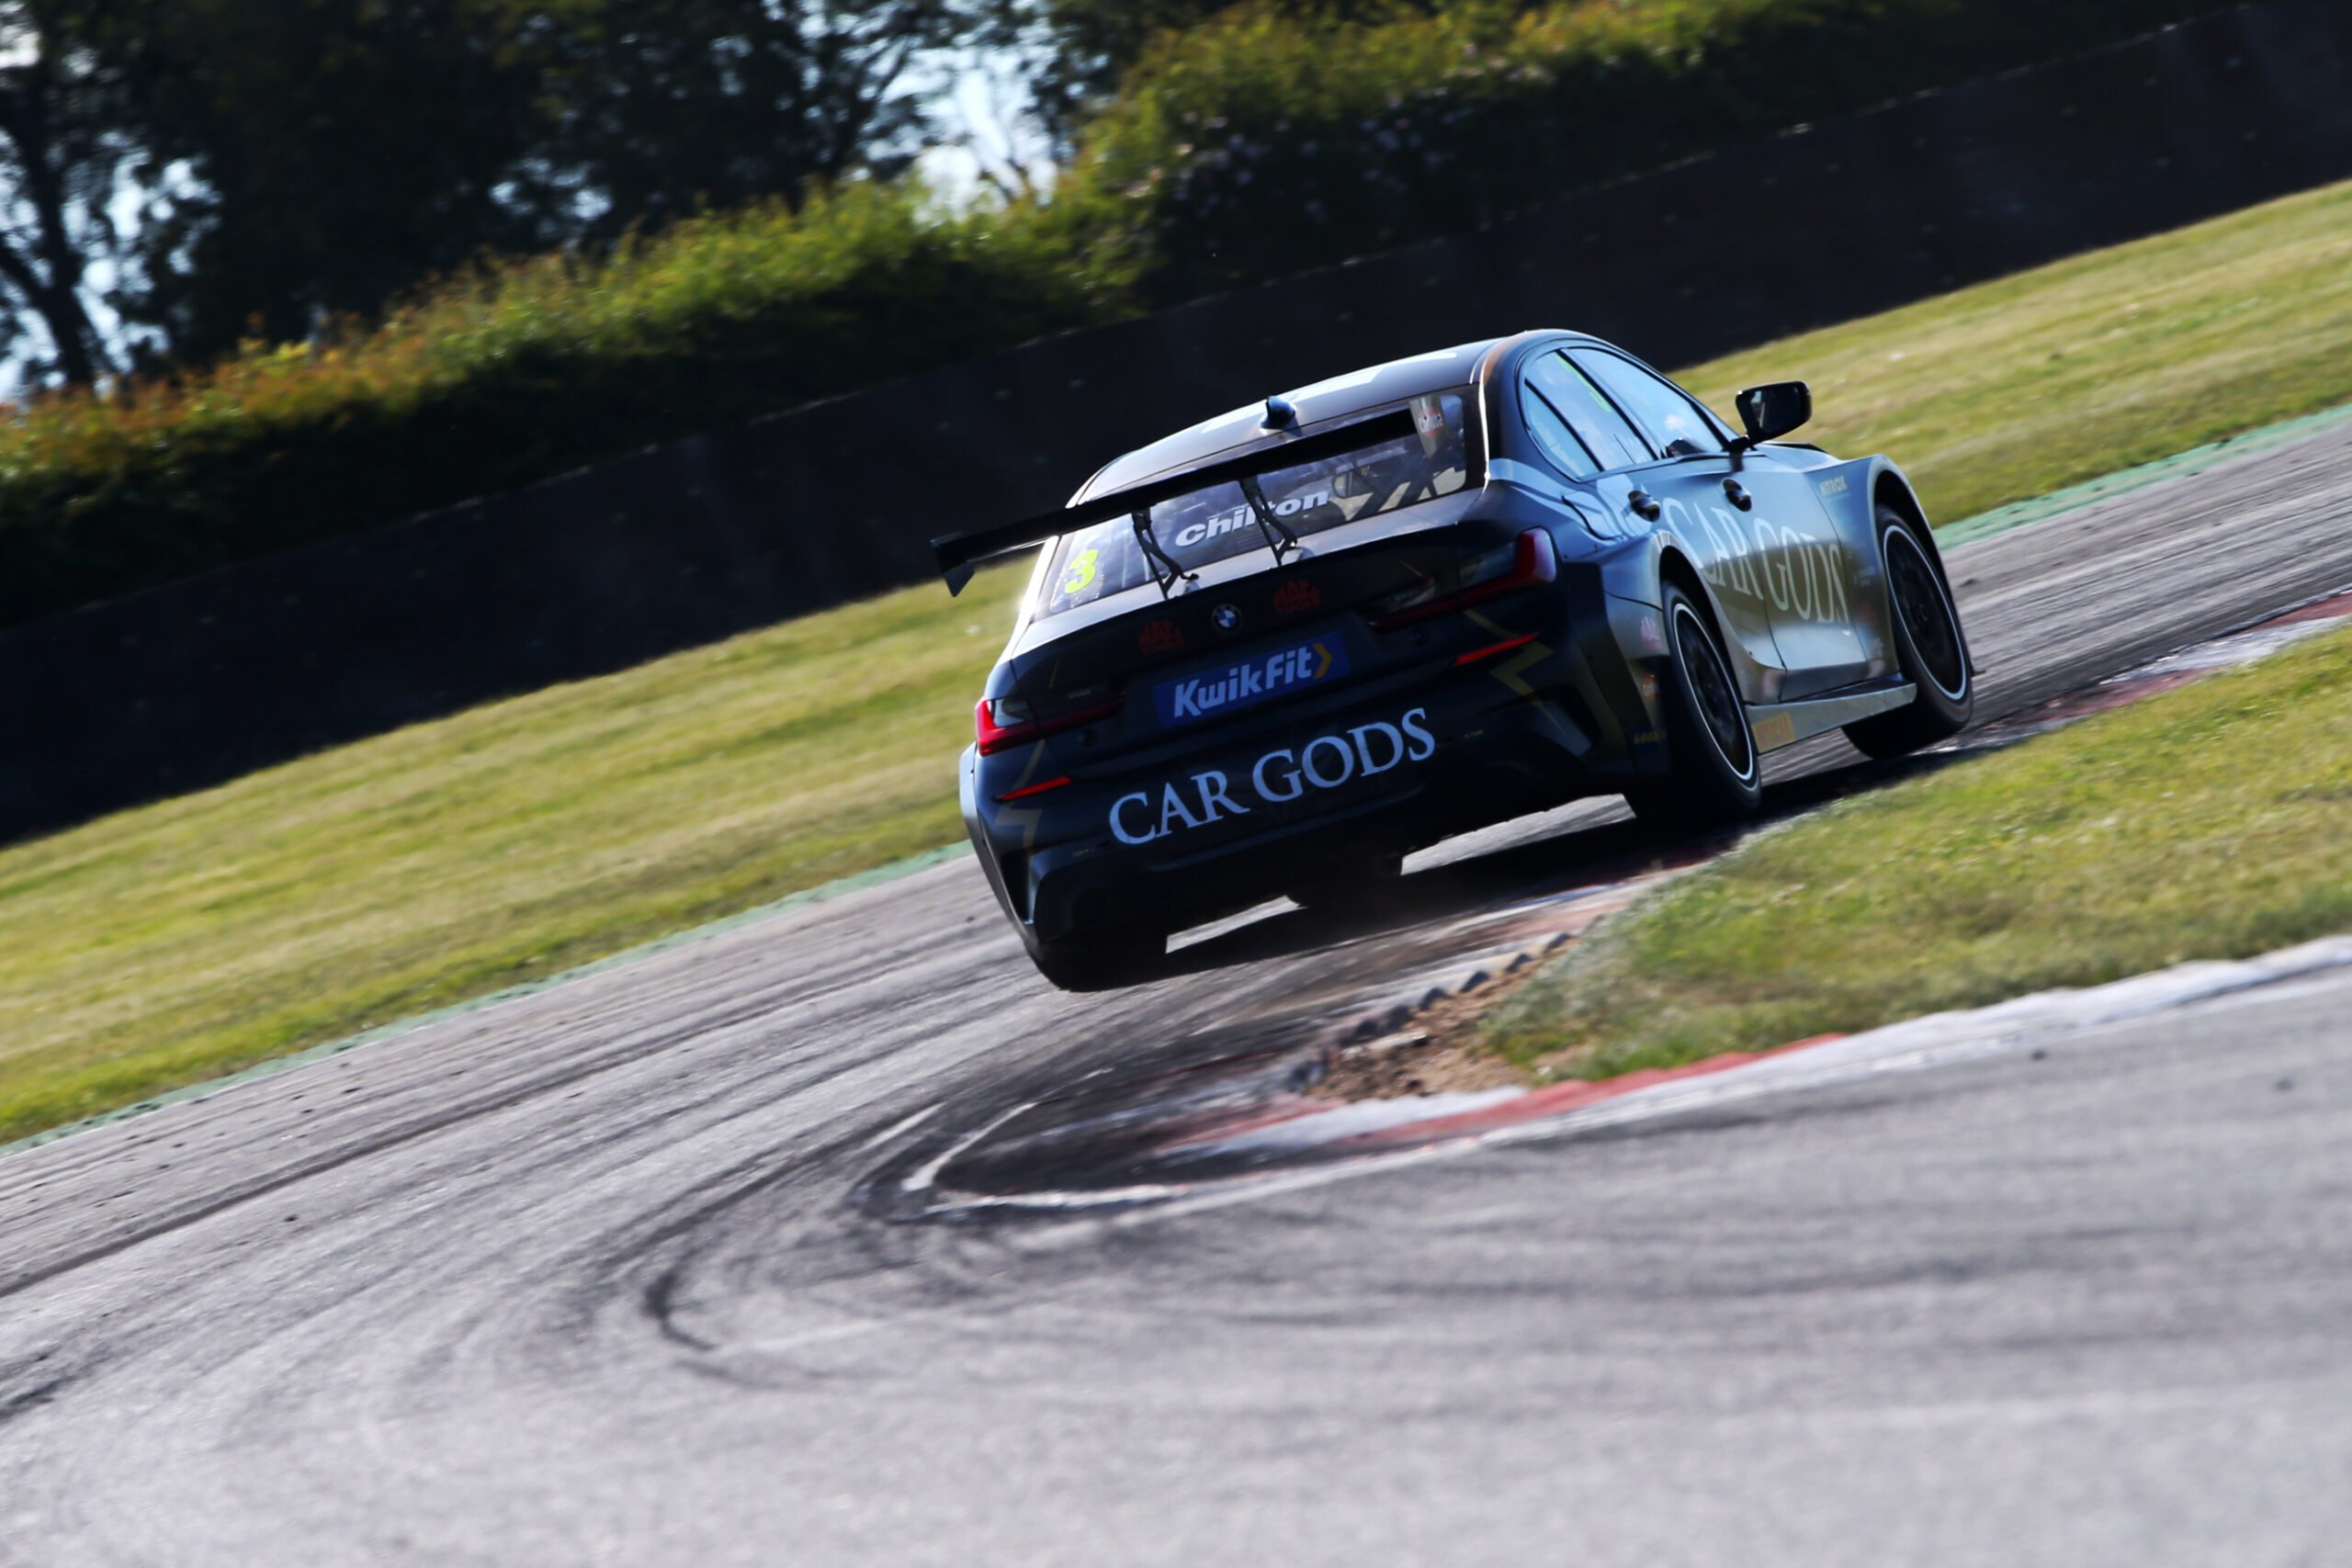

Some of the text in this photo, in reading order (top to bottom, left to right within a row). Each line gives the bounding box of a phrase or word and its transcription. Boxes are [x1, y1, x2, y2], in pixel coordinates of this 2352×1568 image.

[1064, 548, 1098, 594] 3
[1662, 497, 1850, 636] CAR GODS
[1108, 707, 1436, 845] CAR GODS
